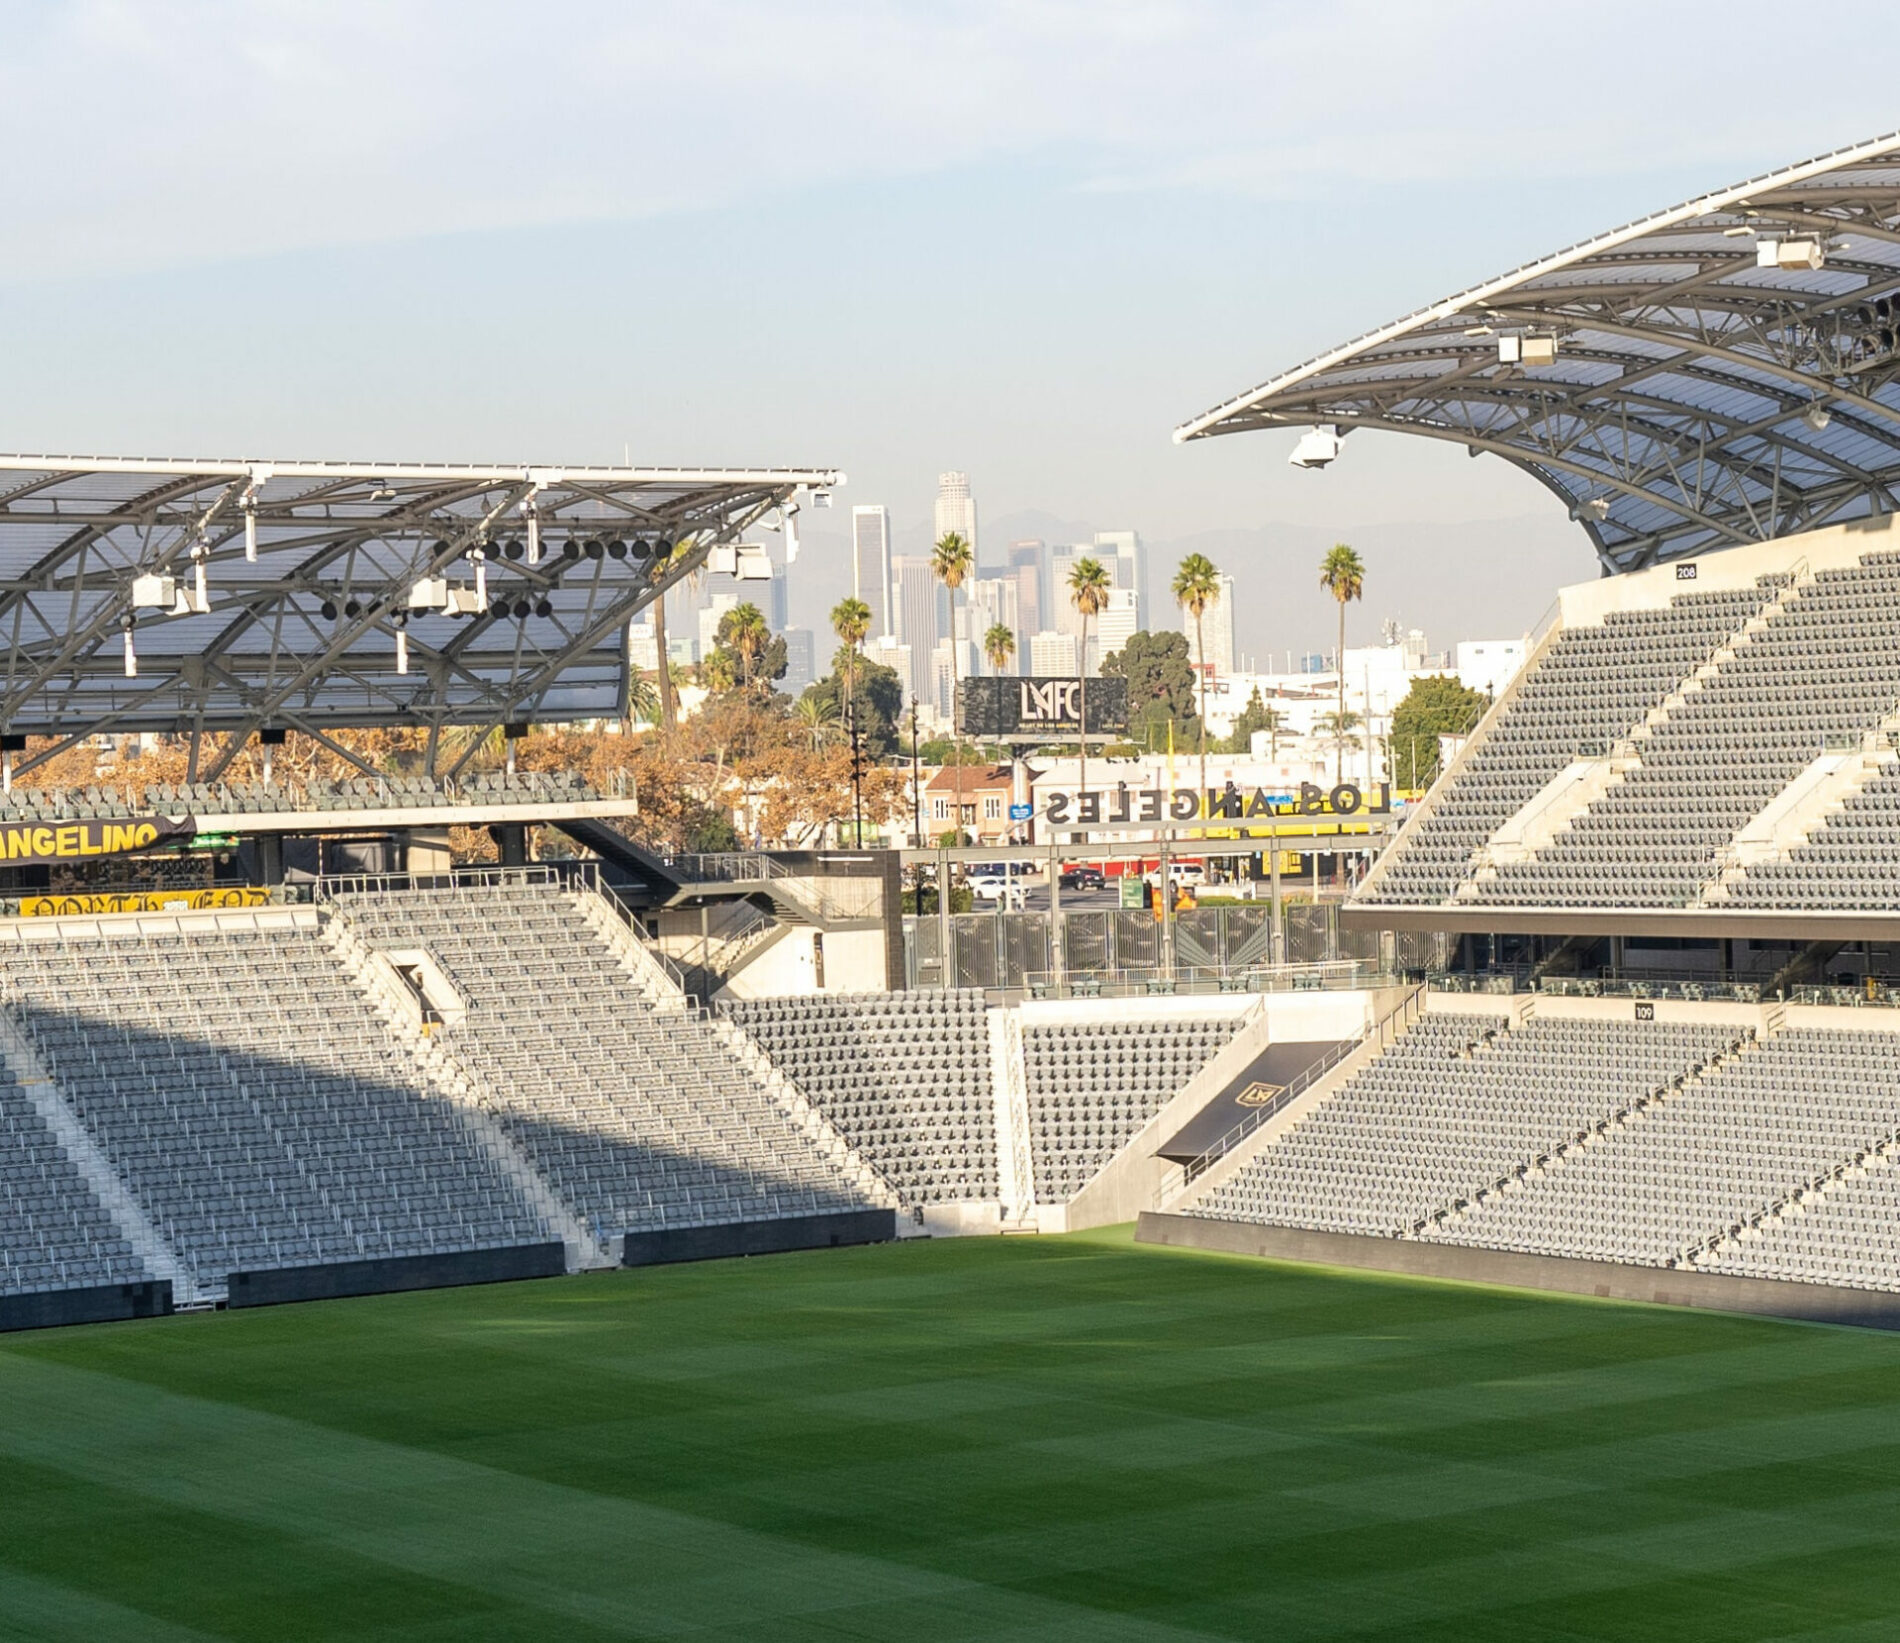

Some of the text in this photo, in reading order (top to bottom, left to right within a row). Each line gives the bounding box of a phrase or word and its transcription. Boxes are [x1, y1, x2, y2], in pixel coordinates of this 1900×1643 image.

[1677, 566, 1696, 579] 208
[1021, 681, 1081, 719] LAFC
[1636, 1006, 1653, 1019] 109
